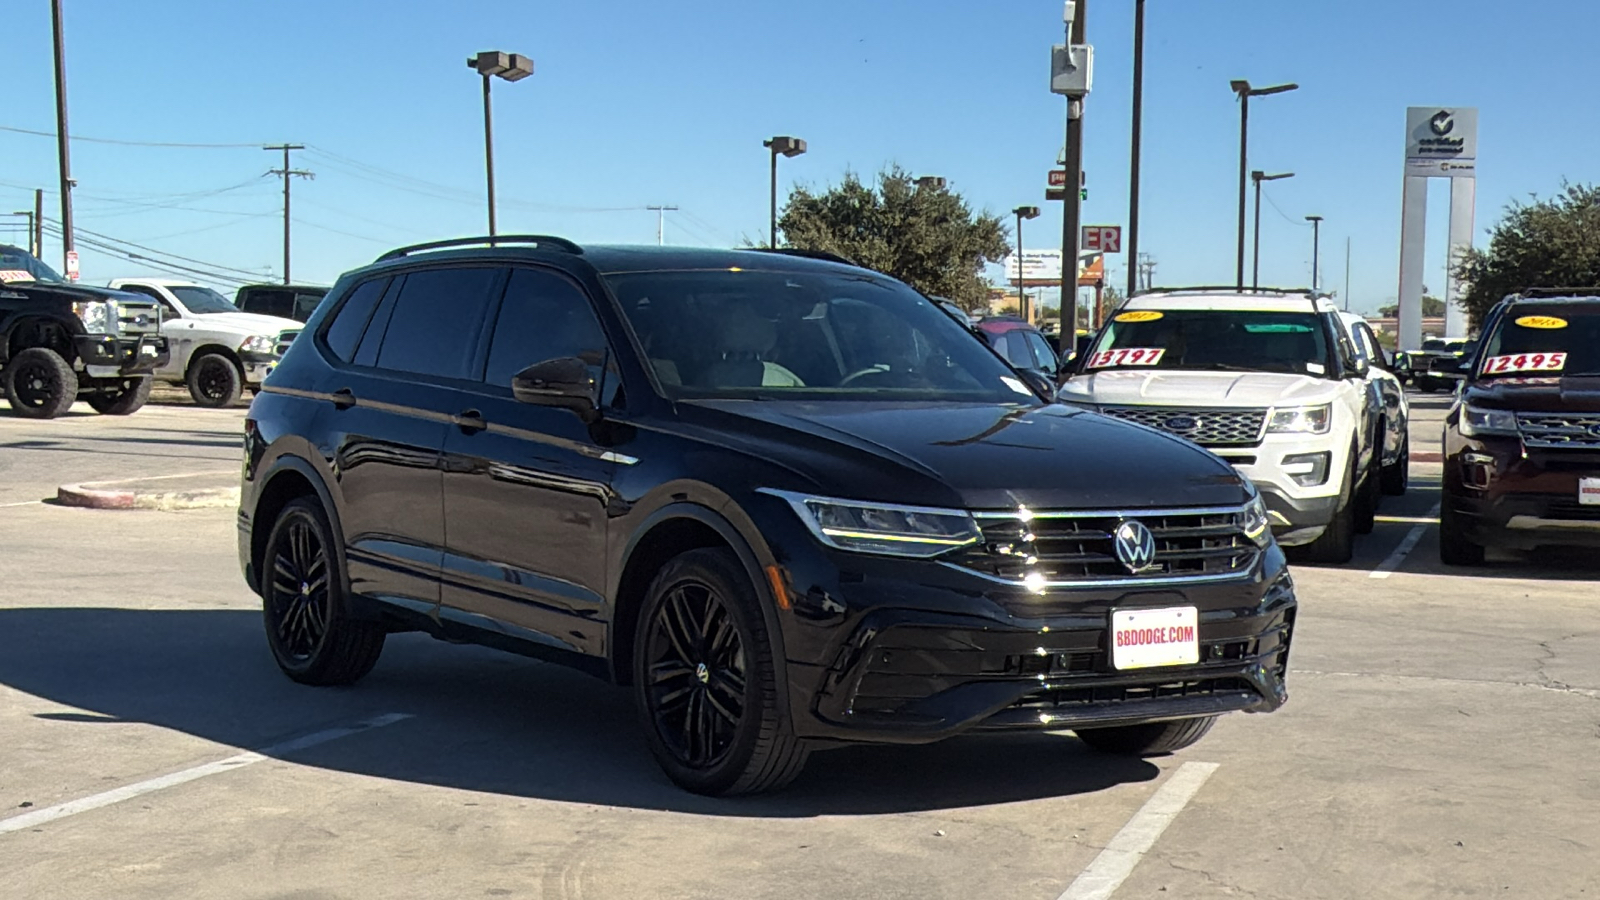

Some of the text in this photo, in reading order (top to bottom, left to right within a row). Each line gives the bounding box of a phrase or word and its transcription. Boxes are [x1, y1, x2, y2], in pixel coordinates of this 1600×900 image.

[1083, 227, 1118, 251] ER
[1090, 349, 1160, 367] 13797
[1484, 354, 1563, 373] 12495
[1117, 625, 1194, 647] BBDODGE.COM
